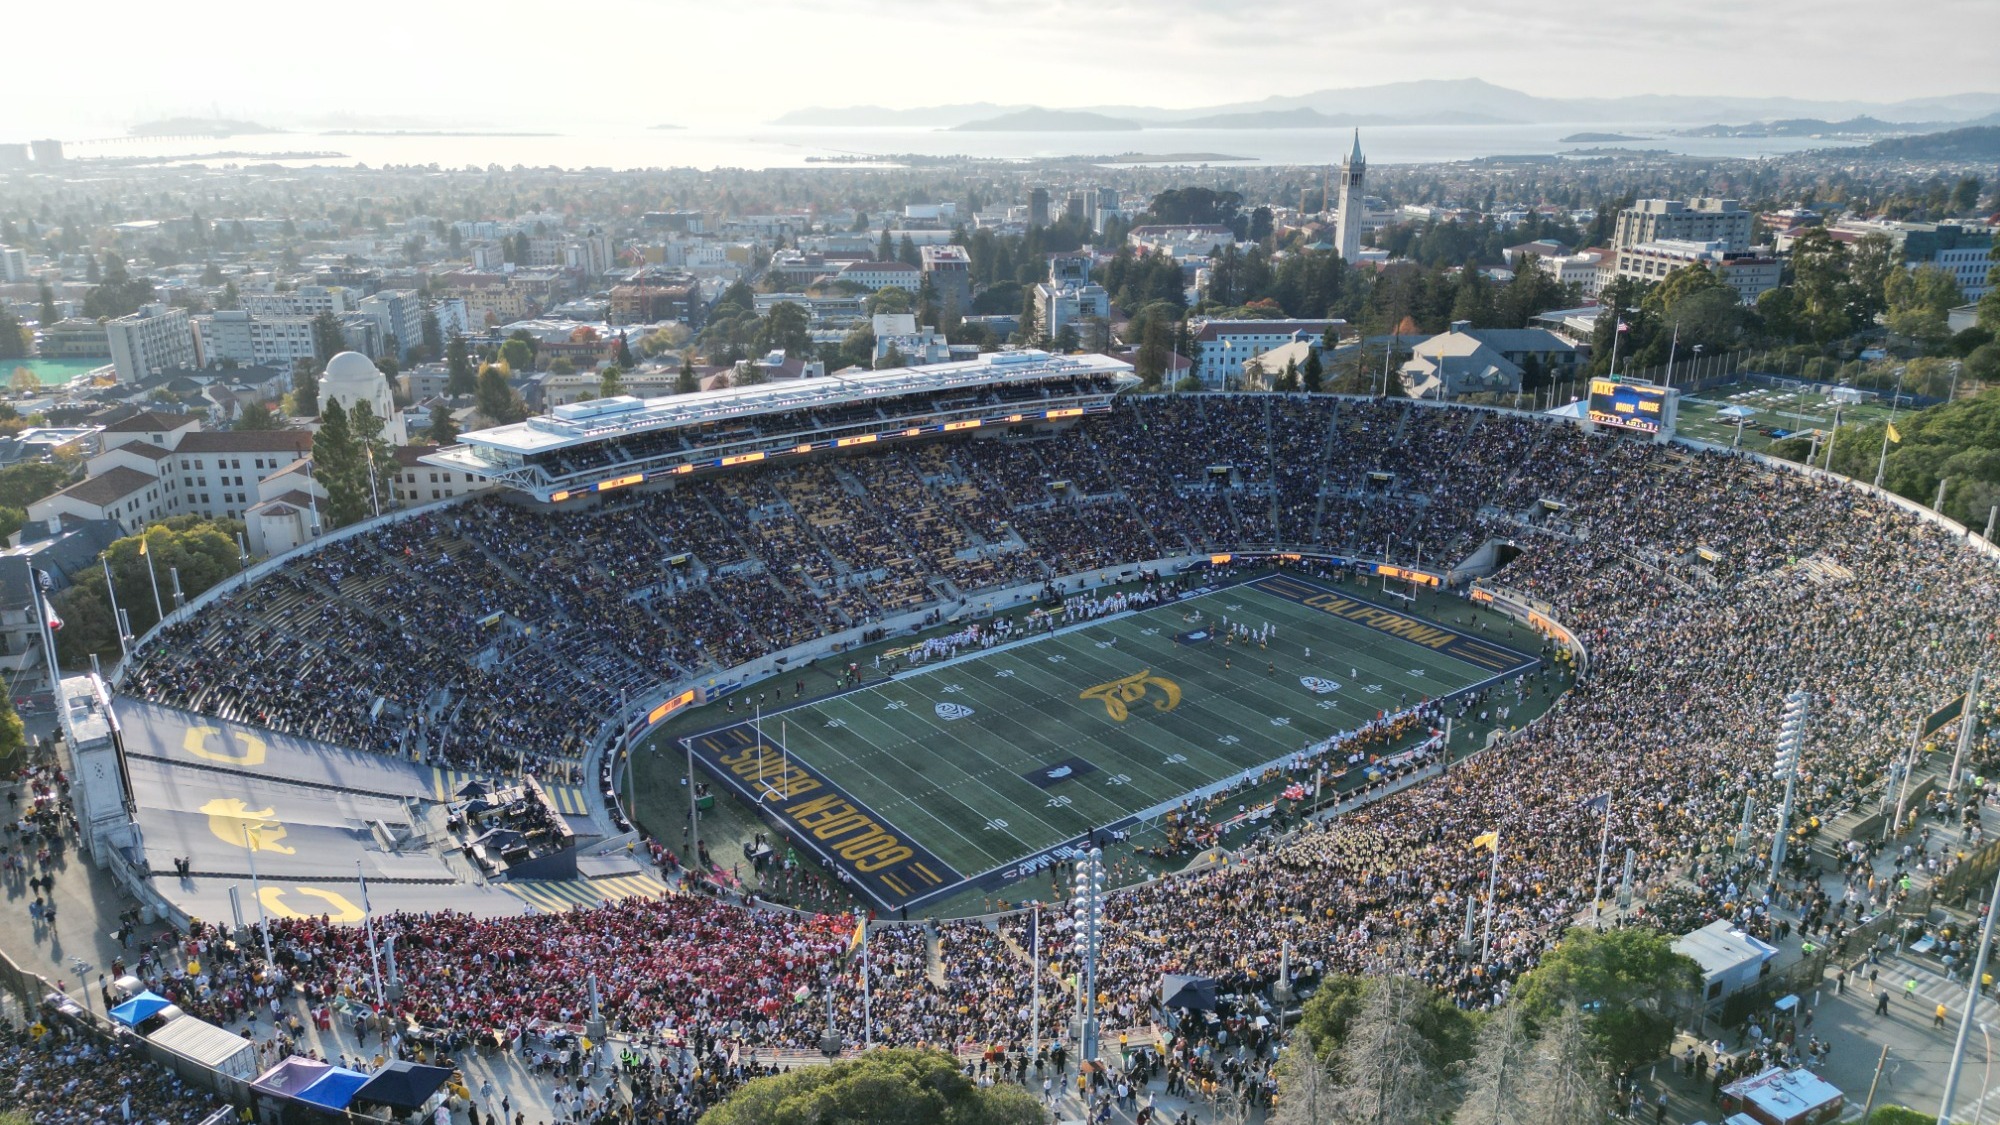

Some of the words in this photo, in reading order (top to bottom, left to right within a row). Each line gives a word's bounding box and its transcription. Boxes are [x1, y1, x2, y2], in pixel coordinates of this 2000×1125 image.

[1615, 402, 1635, 413] MORE
[1638, 400, 1659, 412] NOISE
[1303, 593, 1457, 648] CALIFORNIA
[1080, 669, 1181, 721] Cal
[720, 745, 822, 801] BEARS
[986, 818, 1008, 830] 10
[1048, 795, 1072, 807] 20
[784, 793, 913, 872] GOLDEN
